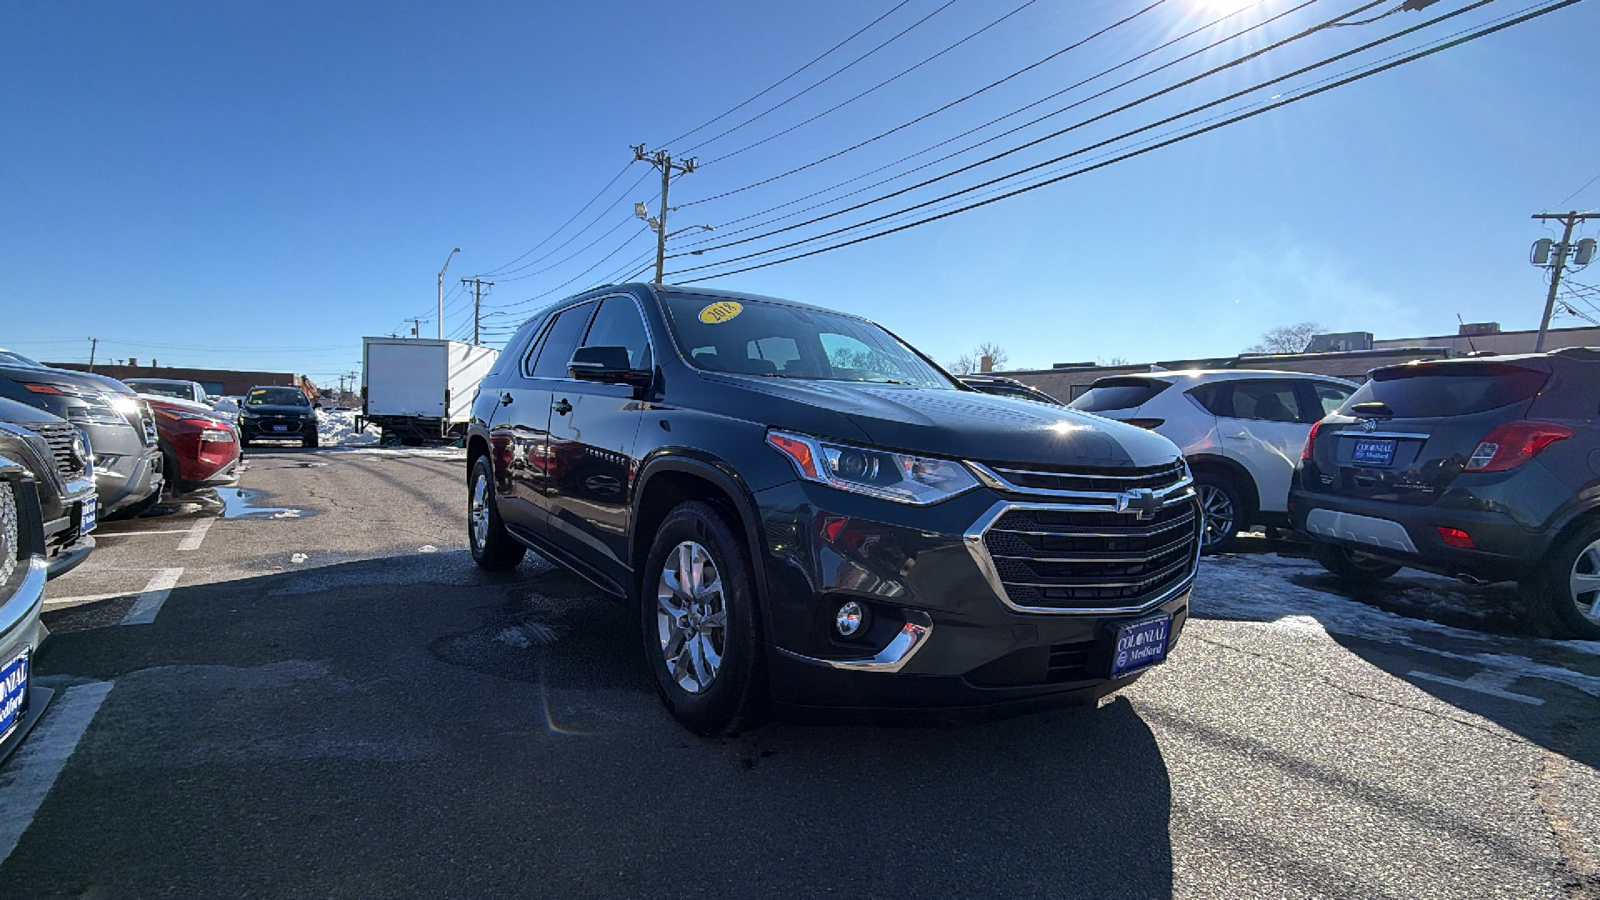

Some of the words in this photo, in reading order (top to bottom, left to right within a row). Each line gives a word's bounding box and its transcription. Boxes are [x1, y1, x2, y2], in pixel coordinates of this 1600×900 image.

[707, 303, 737, 322] 2018
[1356, 443, 1392, 452] COLONIAL
[1117, 627, 1166, 652] COLONIAL
[1129, 643, 1162, 661] Medford
[0, 688, 24, 723] edford
